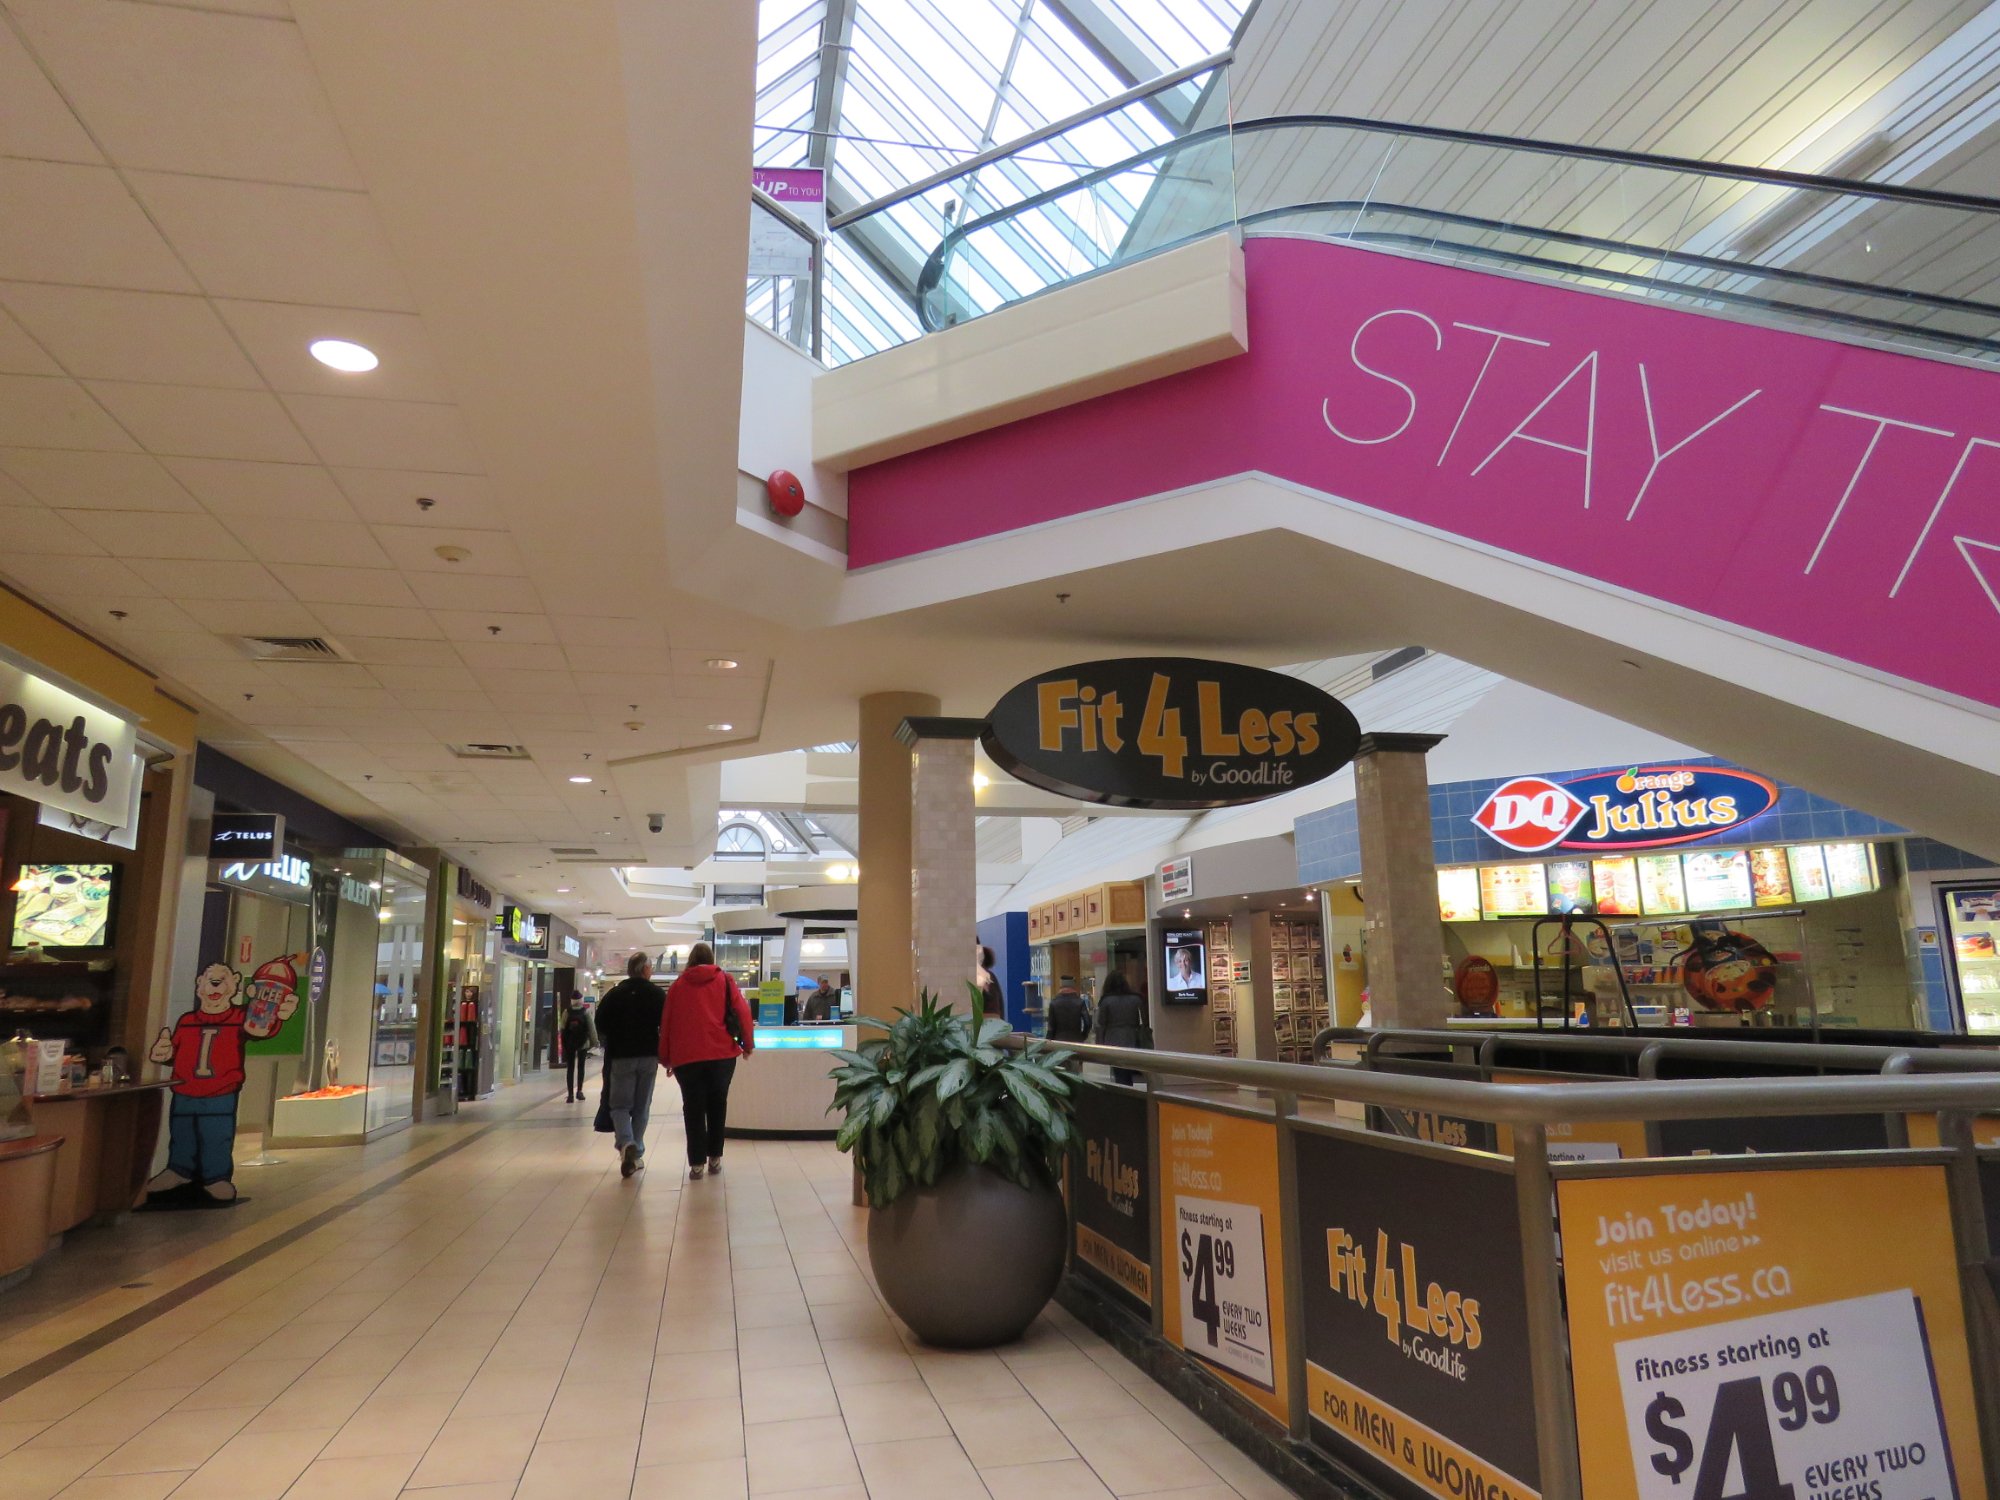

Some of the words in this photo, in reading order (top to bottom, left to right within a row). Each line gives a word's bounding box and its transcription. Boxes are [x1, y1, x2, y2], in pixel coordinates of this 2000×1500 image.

[758, 181, 788, 194] UP
[789, 187, 798, 195] TO
[801, 187, 821, 196] YOU!
[1322, 310, 1762, 521] STAY
[1037, 679, 1125, 753] Fit
[1136, 671, 1188, 778] 4
[1197, 681, 1320, 756] Less
[1192, 769, 1206, 786] by
[1209, 762, 1293, 785] GoodLife
[1616, 768, 1695, 793] Orange
[1490, 790, 1570, 832] DQ
[1587, 791, 1738, 839] Julius
[236, 832, 273, 840] TELUS
[257, 987, 282, 1002] ICEE
[1087, 1139, 1102, 1186] Fit
[1103, 1137, 1112, 1202] 4
[1113, 1144, 1139, 1199] Less
[1200, 1213, 1224, 1232] starting
[1225, 1217, 1233, 1231] at
[1595, 1212, 1654, 1246] Join
[1660, 1192, 1758, 1233] Today!
[1117, 1254, 1148, 1294] WOMEN
[1600, 1251, 1643, 1275] visit
[1650, 1248, 1672, 1266] us
[1679, 1235, 1739, 1261] online
[1326, 1228, 1368, 1309] Fit
[1373, 1227, 1400, 1346] 4
[1401, 1242, 1482, 1350] Less
[1222, 1301, 1242, 1320] EVERY
[1244, 1307, 1262, 1327] TWO
[1223, 1319, 1247, 1340] WEEKS
[1402, 1338, 1412, 1359] by
[1412, 1336, 1466, 1381] GoodLife
[1635, 1351, 1710, 1382] fitness
[1718, 1335, 1800, 1366] starting
[1808, 1328, 1831, 1350] at
[1323, 1390, 1349, 1426] FOR
[1354, 1401, 1396, 1454] MEN
[1402, 1437, 1417, 1467] &
[1805, 1454, 1868, 1489] EVERY
[1874, 1442, 1926, 1473] TWO
